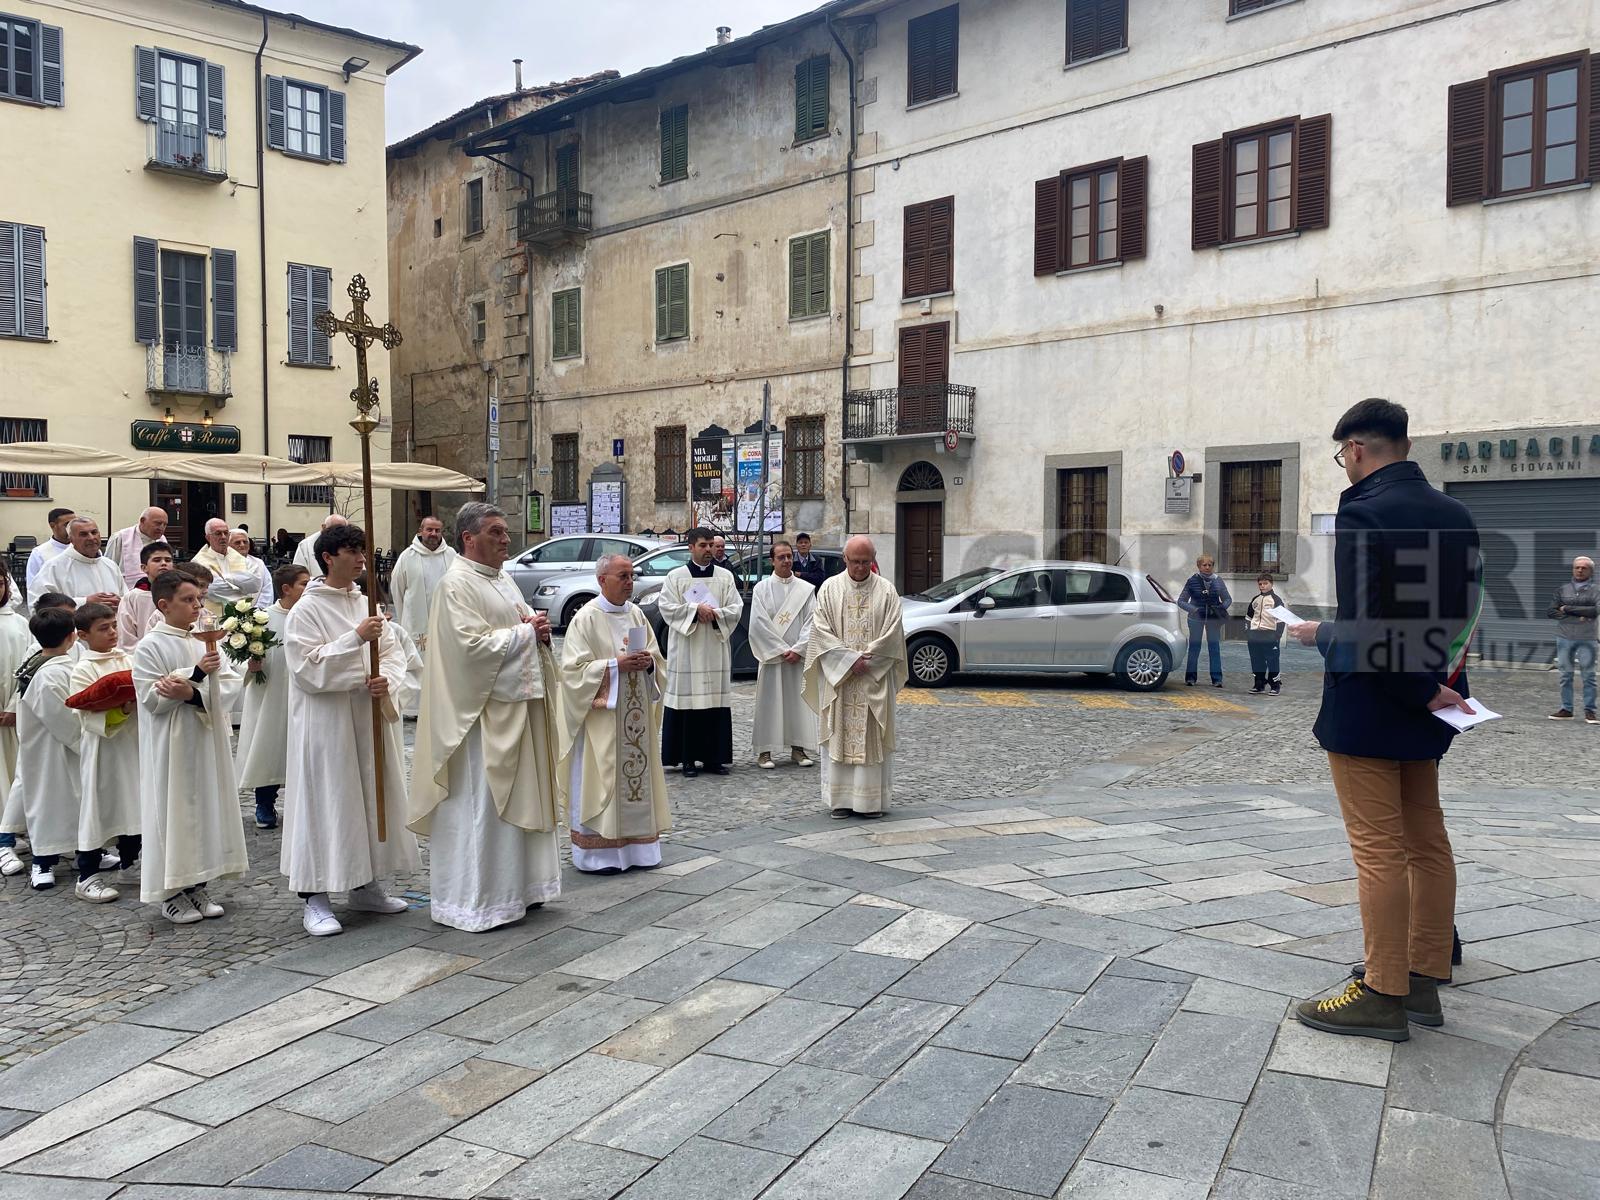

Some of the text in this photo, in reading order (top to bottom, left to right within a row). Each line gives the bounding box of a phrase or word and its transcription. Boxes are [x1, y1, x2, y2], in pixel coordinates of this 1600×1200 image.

[197, 431, 237, 446] Roma
[693, 448, 706, 456] MIA
[1441, 434, 1600, 461] FARMACIA
[694, 455, 718, 463] MOGLIE
[1463, 461, 1582, 474] SAN GIOVANNI
[694, 470, 721, 478] TRADITO
